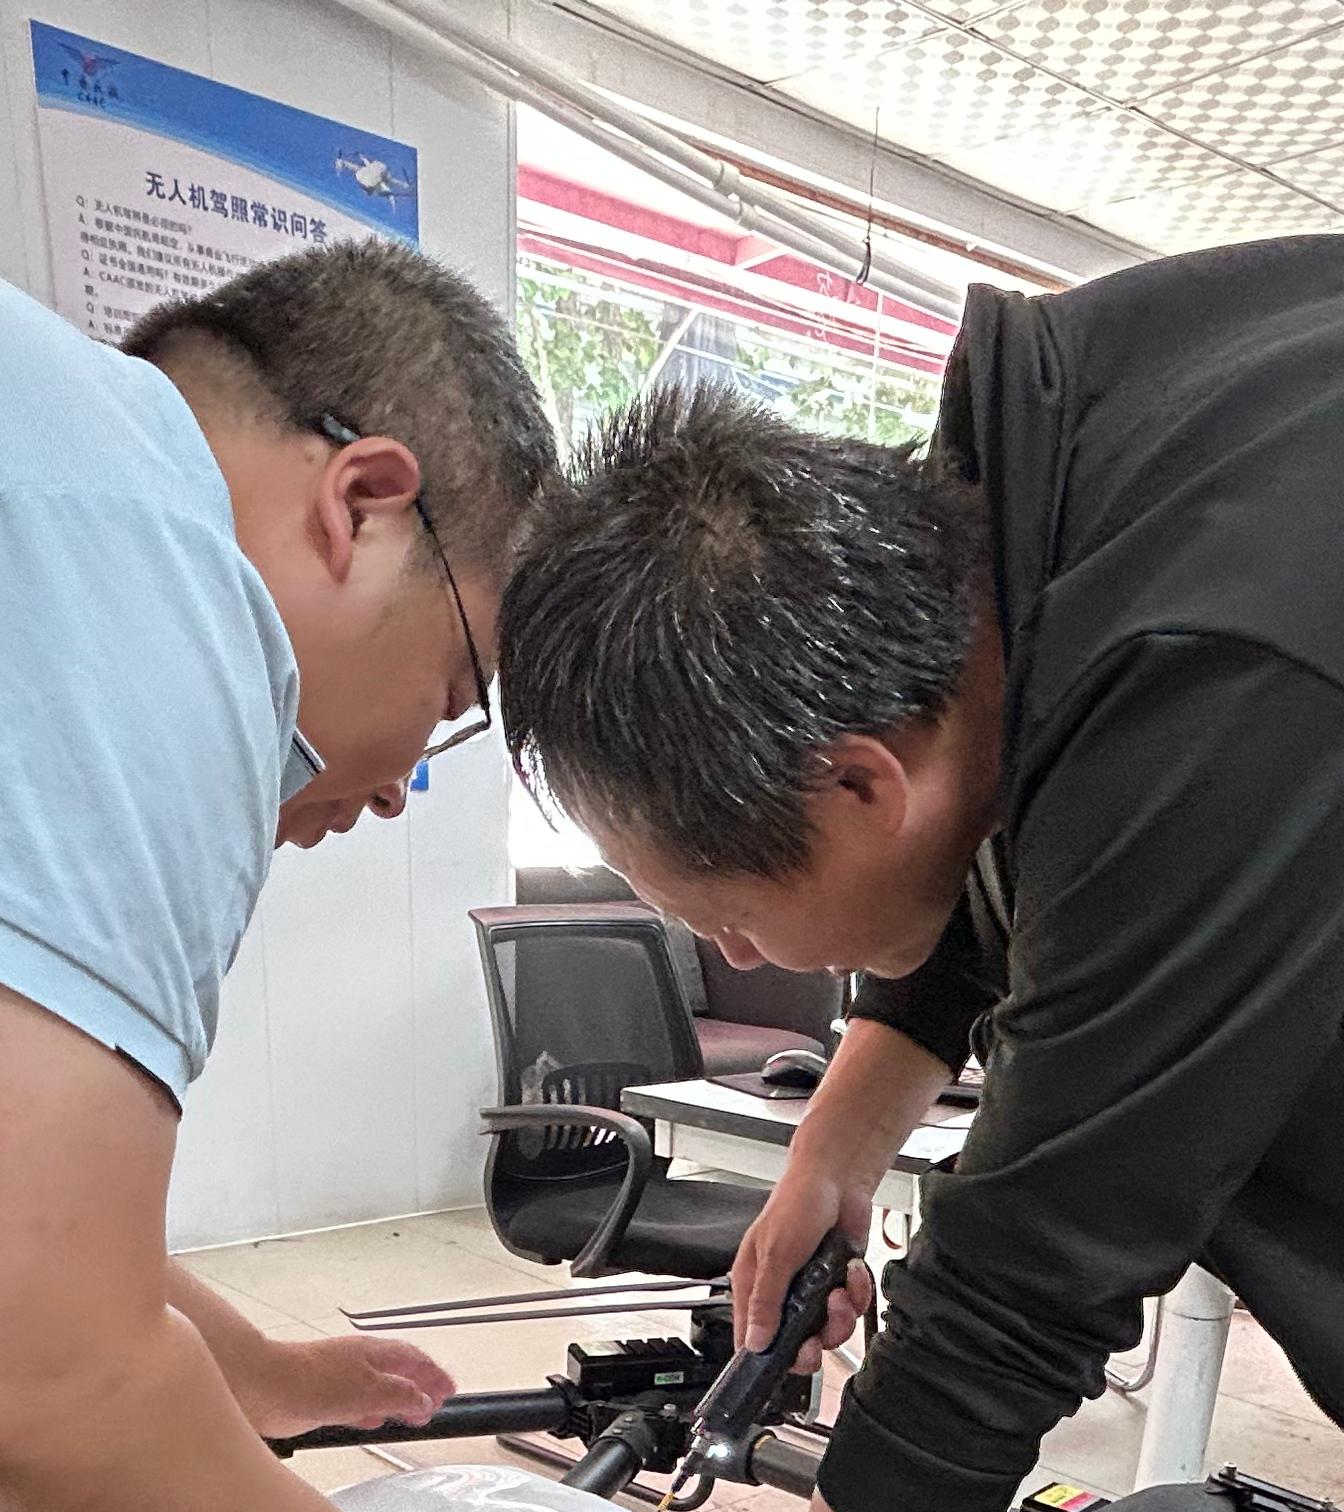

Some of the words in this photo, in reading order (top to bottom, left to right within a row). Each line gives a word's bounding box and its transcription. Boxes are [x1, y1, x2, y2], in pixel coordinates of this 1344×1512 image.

[145, 171, 328, 244] 无人机驾照常识问答
